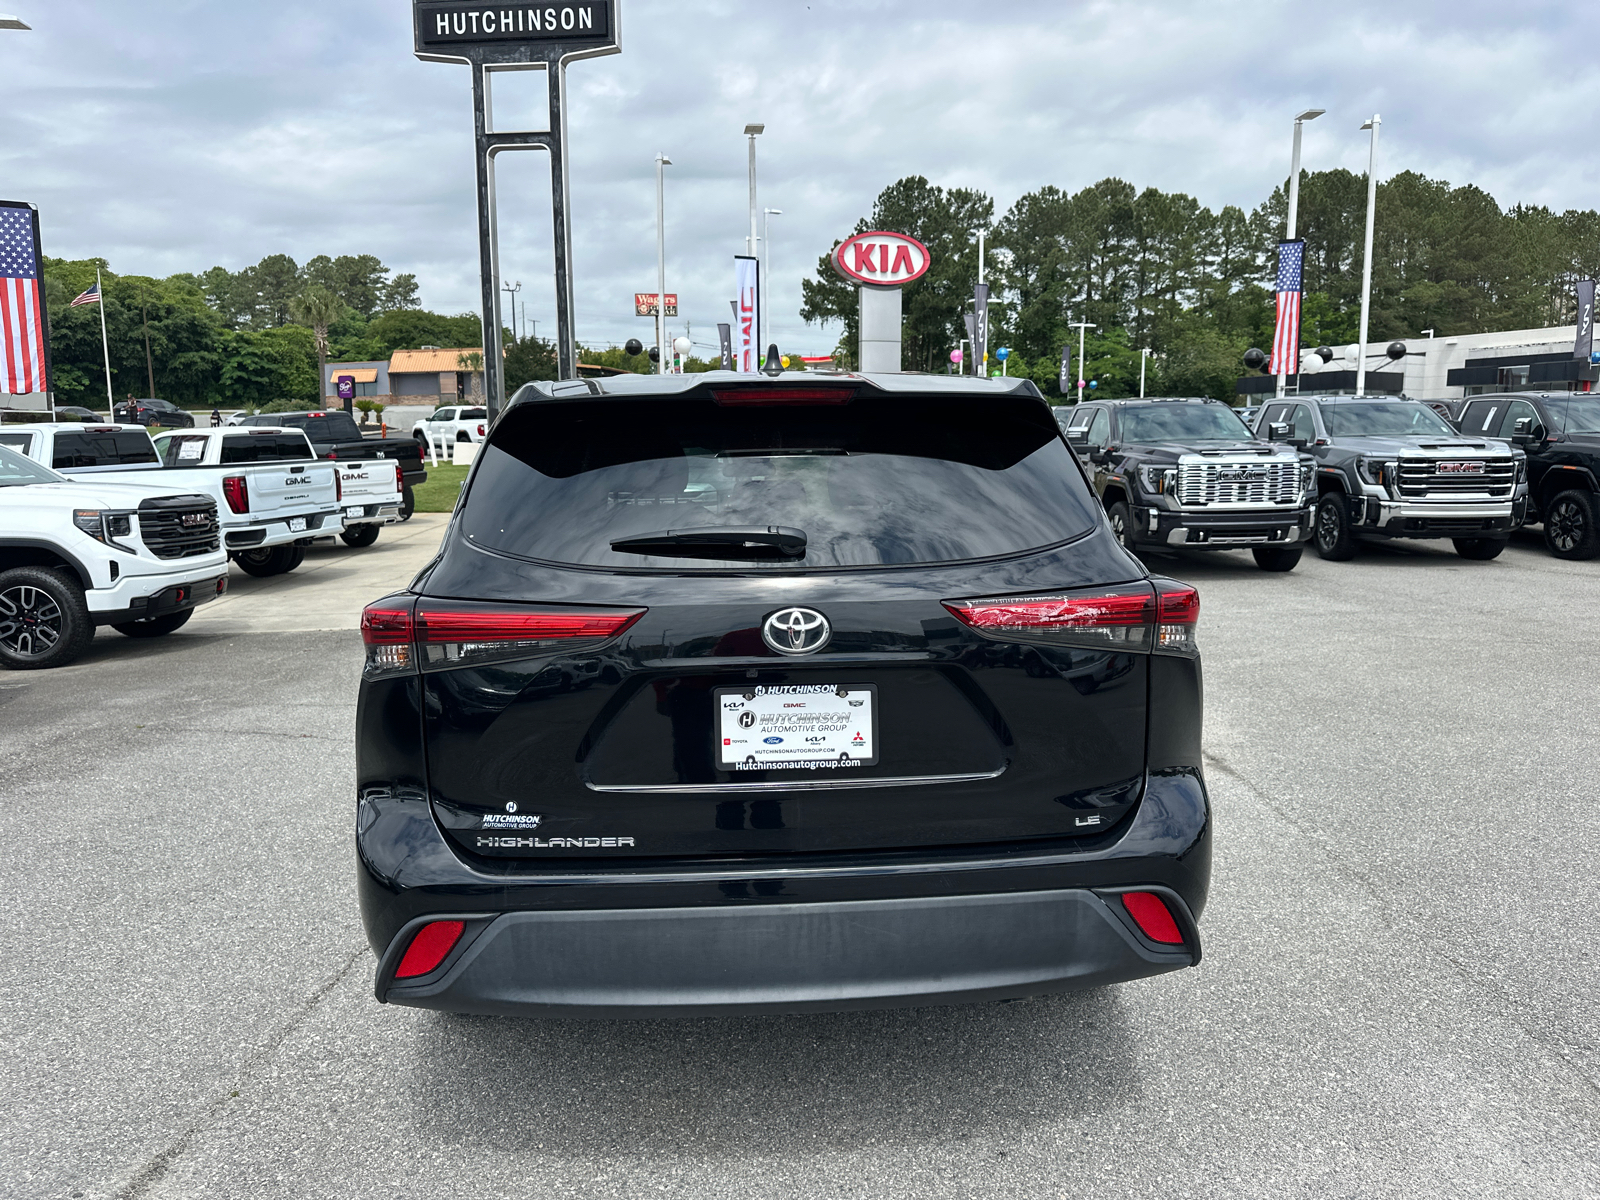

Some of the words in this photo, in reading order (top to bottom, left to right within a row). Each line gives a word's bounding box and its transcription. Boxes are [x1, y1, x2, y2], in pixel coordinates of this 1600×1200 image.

[436, 7, 592, 35] HUTCHINSON
[853, 242, 915, 274] KIA
[637, 295, 676, 305] Wagrs
[1439, 462, 1485, 473] GMC
[285, 476, 312, 486] GMC
[342, 472, 369, 481] GMC
[767, 684, 838, 695] HUTCHINSON
[760, 724, 816, 733] AUTOMOTIVE
[817, 724, 848, 732] GROUP
[754, 747, 836, 755] HUTCHINSONAUTOGROUP.COM
[735, 759, 861, 771] Hutchinsonautogroup.com
[482, 814, 541, 823] HUTCHINSON
[1075, 814, 1101, 826] LE
[476, 836, 635, 848] HIGHLANDER
